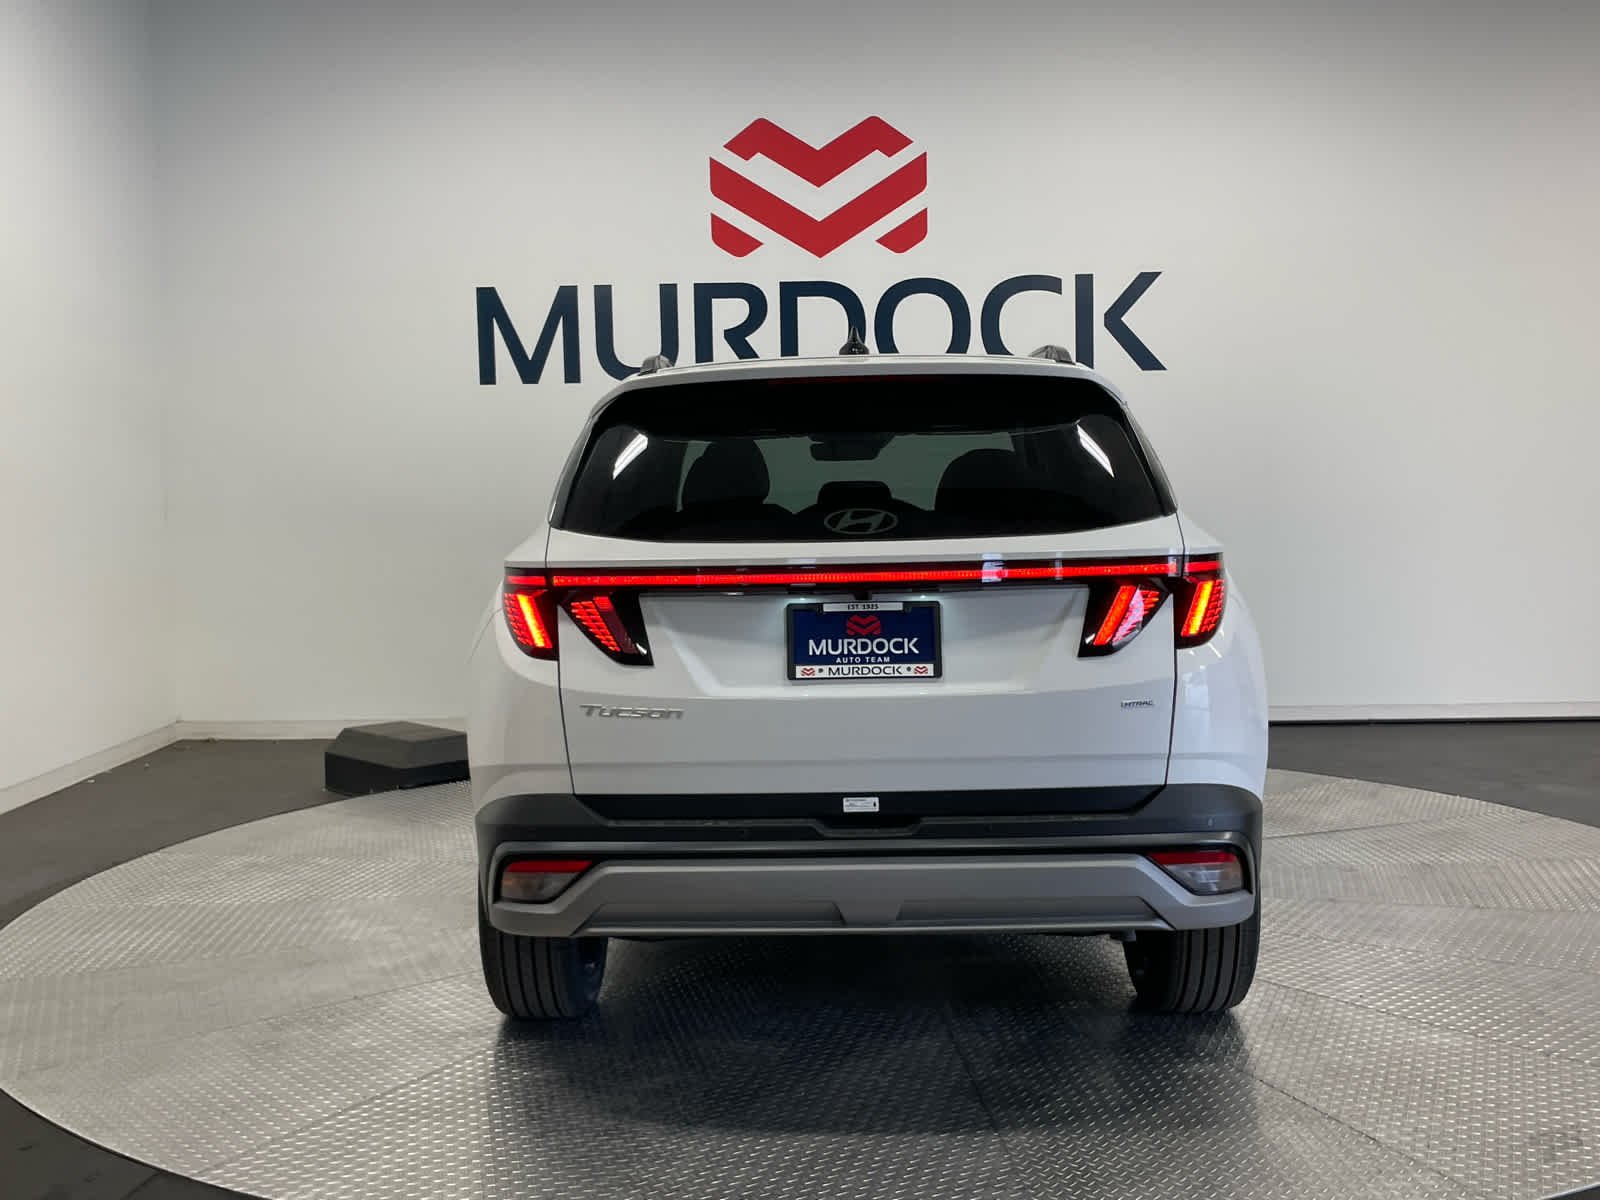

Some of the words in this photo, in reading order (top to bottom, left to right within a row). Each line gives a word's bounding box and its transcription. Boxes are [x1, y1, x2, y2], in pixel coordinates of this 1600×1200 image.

[476, 271, 1167, 386] MURDOCK
[808, 637, 920, 656] MURDOCK
[828, 665, 904, 677] MURDOCK
